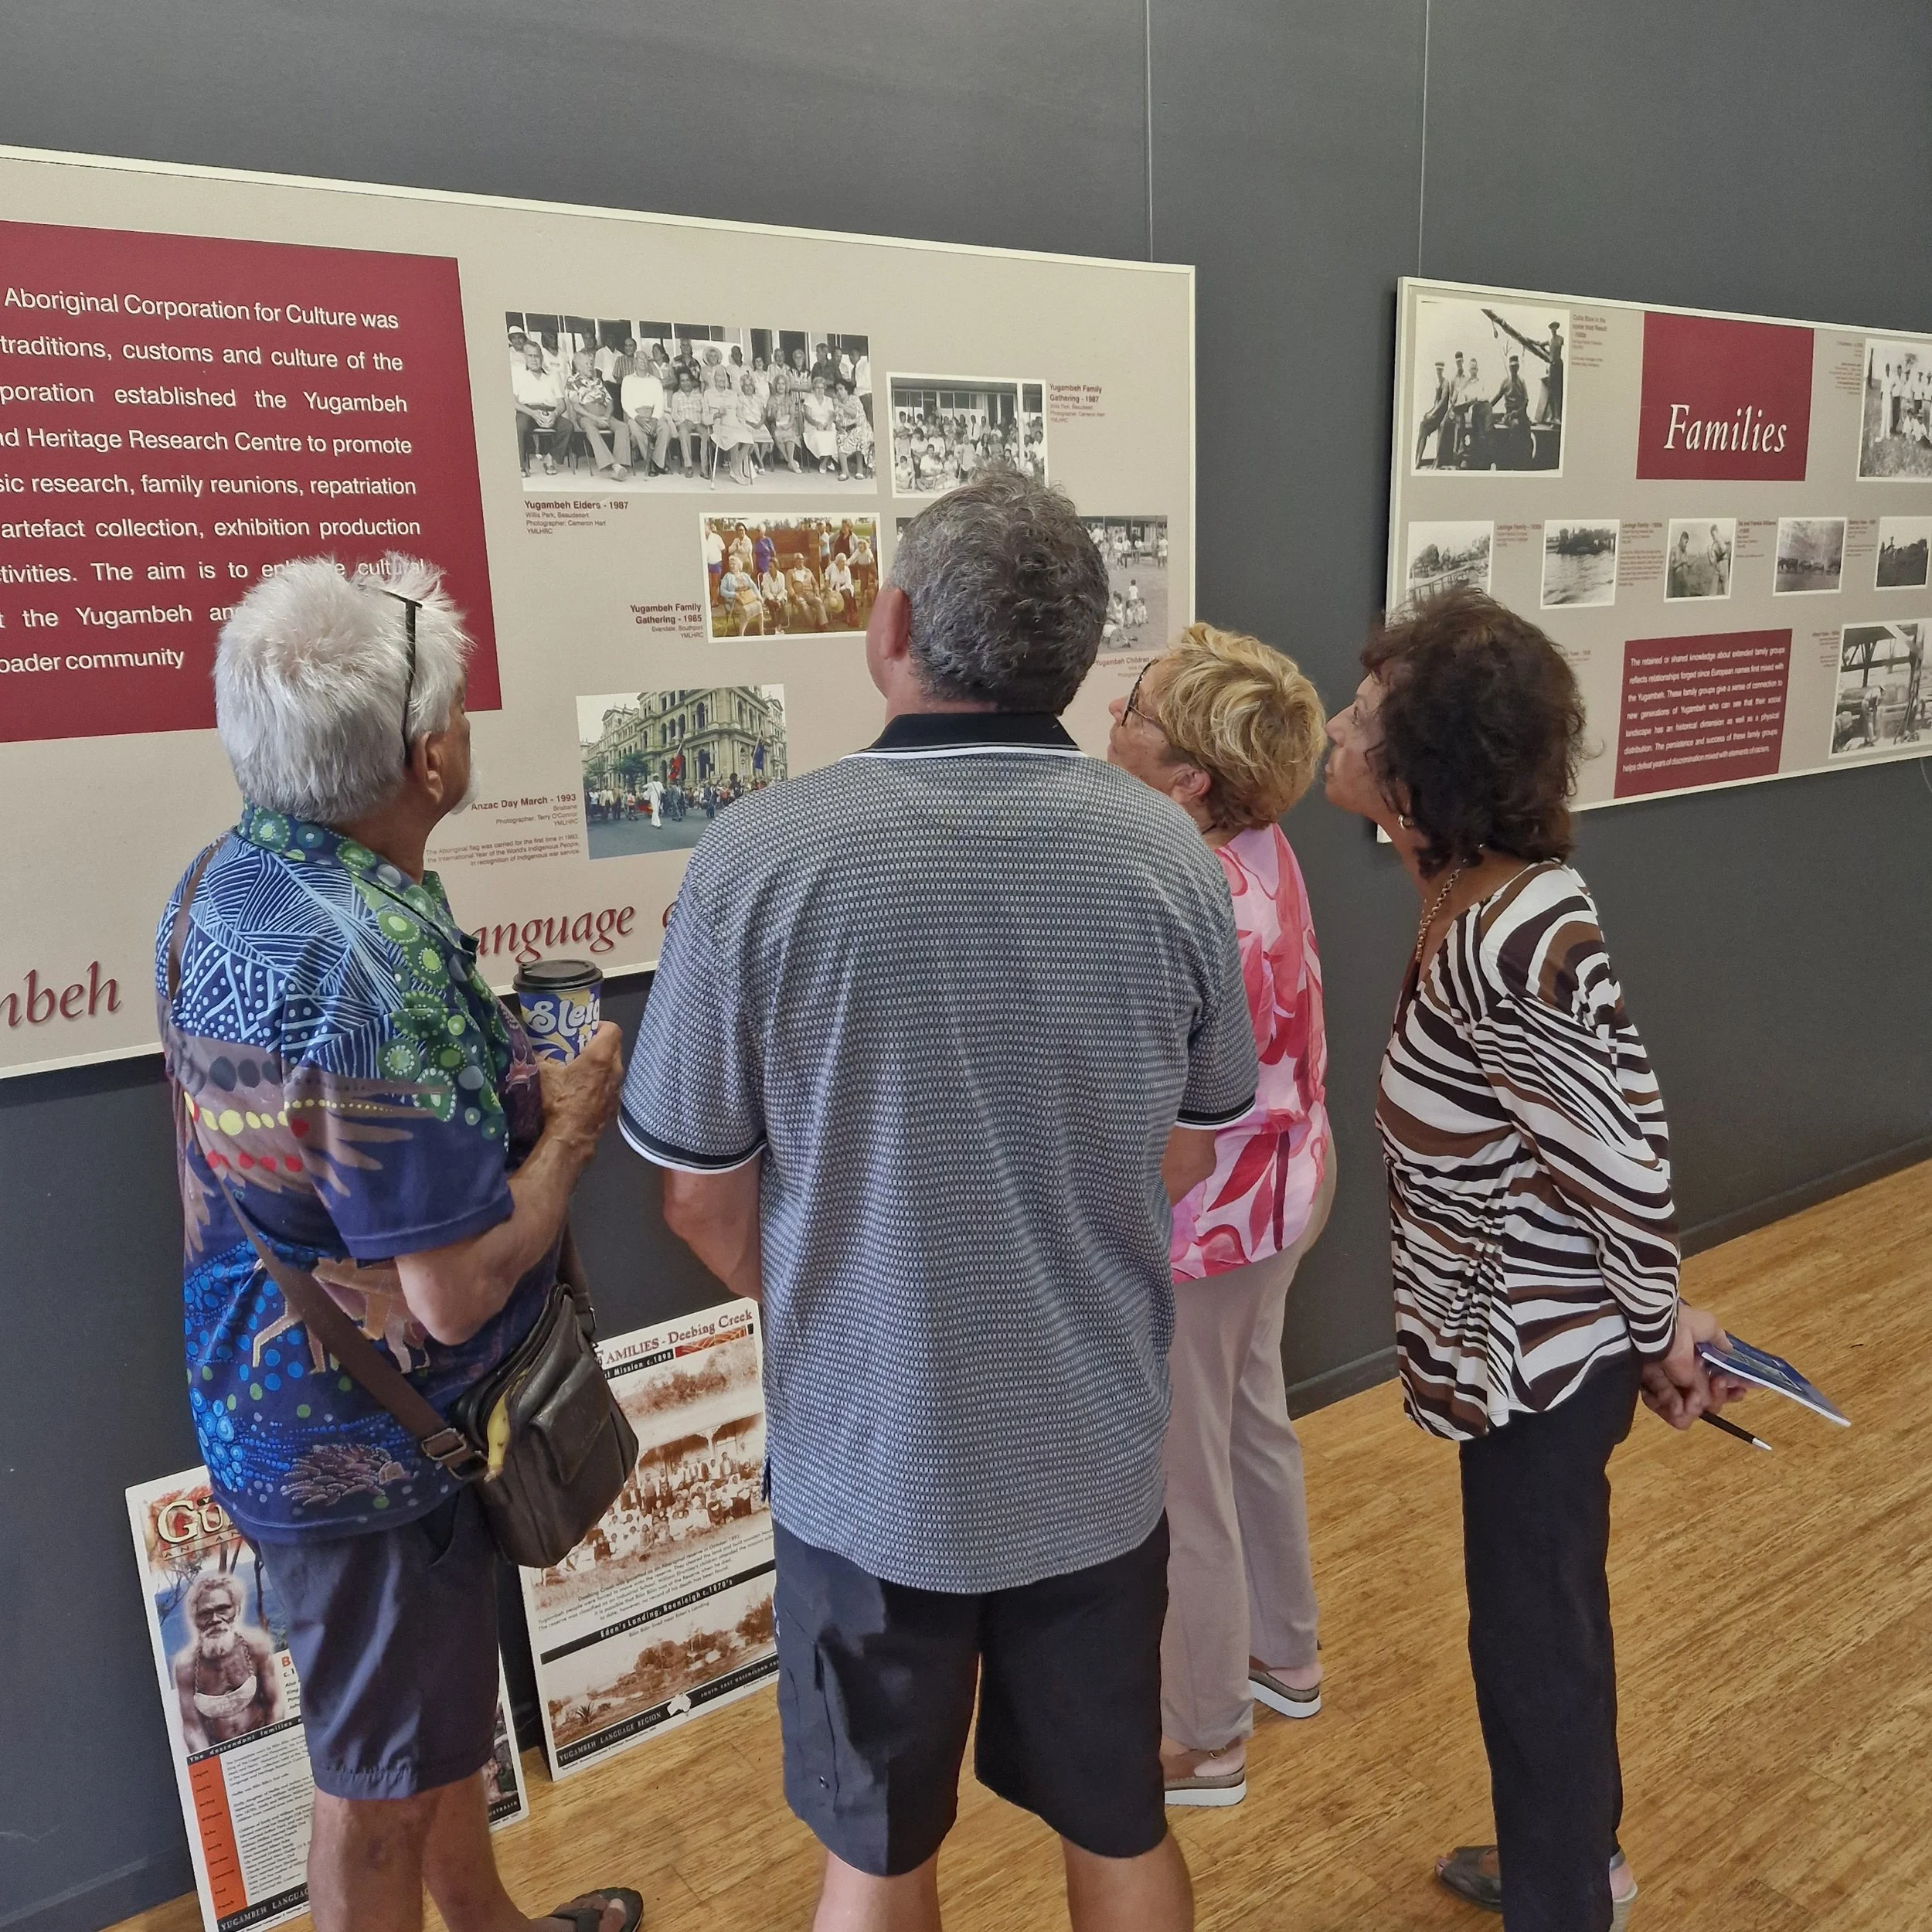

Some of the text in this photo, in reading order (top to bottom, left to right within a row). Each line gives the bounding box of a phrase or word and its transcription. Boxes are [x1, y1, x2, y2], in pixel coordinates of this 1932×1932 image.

[4, 288, 399, 328] Aboriginal Corporation for Culture was
[0, 335, 403, 370] traditions, customs and culture of the
[114, 386, 236, 406] established
[253, 389, 286, 408] the
[302, 392, 407, 414] Yugambeh
[1049, 383, 1102, 394] Yugambeh Family
[1049, 393, 1080, 403] Gathering
[1663, 403, 1787, 453] Families
[26, 428, 122, 452] Heritage
[128, 430, 229, 449] Research
[234, 432, 301, 451] Centre
[306, 435, 326, 451] to
[332, 437, 412, 455] promote
[31, 474, 134, 495] research,
[140, 474, 203, 497] family
[209, 476, 303, 496] reunions,
[309, 477, 417, 497] repatriation
[523, 500, 571, 511] Yugambeh
[573, 500, 601, 509] Elders
[609, 501, 628, 509] 1987
[1, 518, 420, 538] artefact collection, exhibition production
[90, 562, 133, 580] The
[147, 562, 185, 580] aim
[198, 560, 216, 579] is
[227, 561, 248, 578] to
[21, 608, 59, 627] the
[75, 605, 192, 628] Yugambeh
[209, 607, 234, 621] an
[629, 603, 701, 614] Yugambeh Family
[634, 615, 675, 624] Gathering
[683, 614, 702, 622] 1985
[65, 649, 184, 669] community
[469, 801, 498, 810] Anzac
[500, 799, 519, 808] Day
[519, 796, 548, 805] March
[556, 793, 576, 802] 1993
[668, 1323, 716, 1345] Deebing
[718, 1309, 753, 1328] Creek
[614, 1360, 643, 1376] Mission
[600, 1622, 626, 1638] Eden's
[627, 1610, 662, 1631] Landing,
[663, 1592, 701, 1611] Beenleigh
[189, 1753, 204, 1762] The
[260, 1722, 293, 1737] families
[559, 1741, 596, 1761] YUGAMBEH
[600, 1723, 634, 1743] LANGUAGE
[637, 1713, 661, 1727] REGION
[221, 1906, 267, 1930] YUGAMBEH
